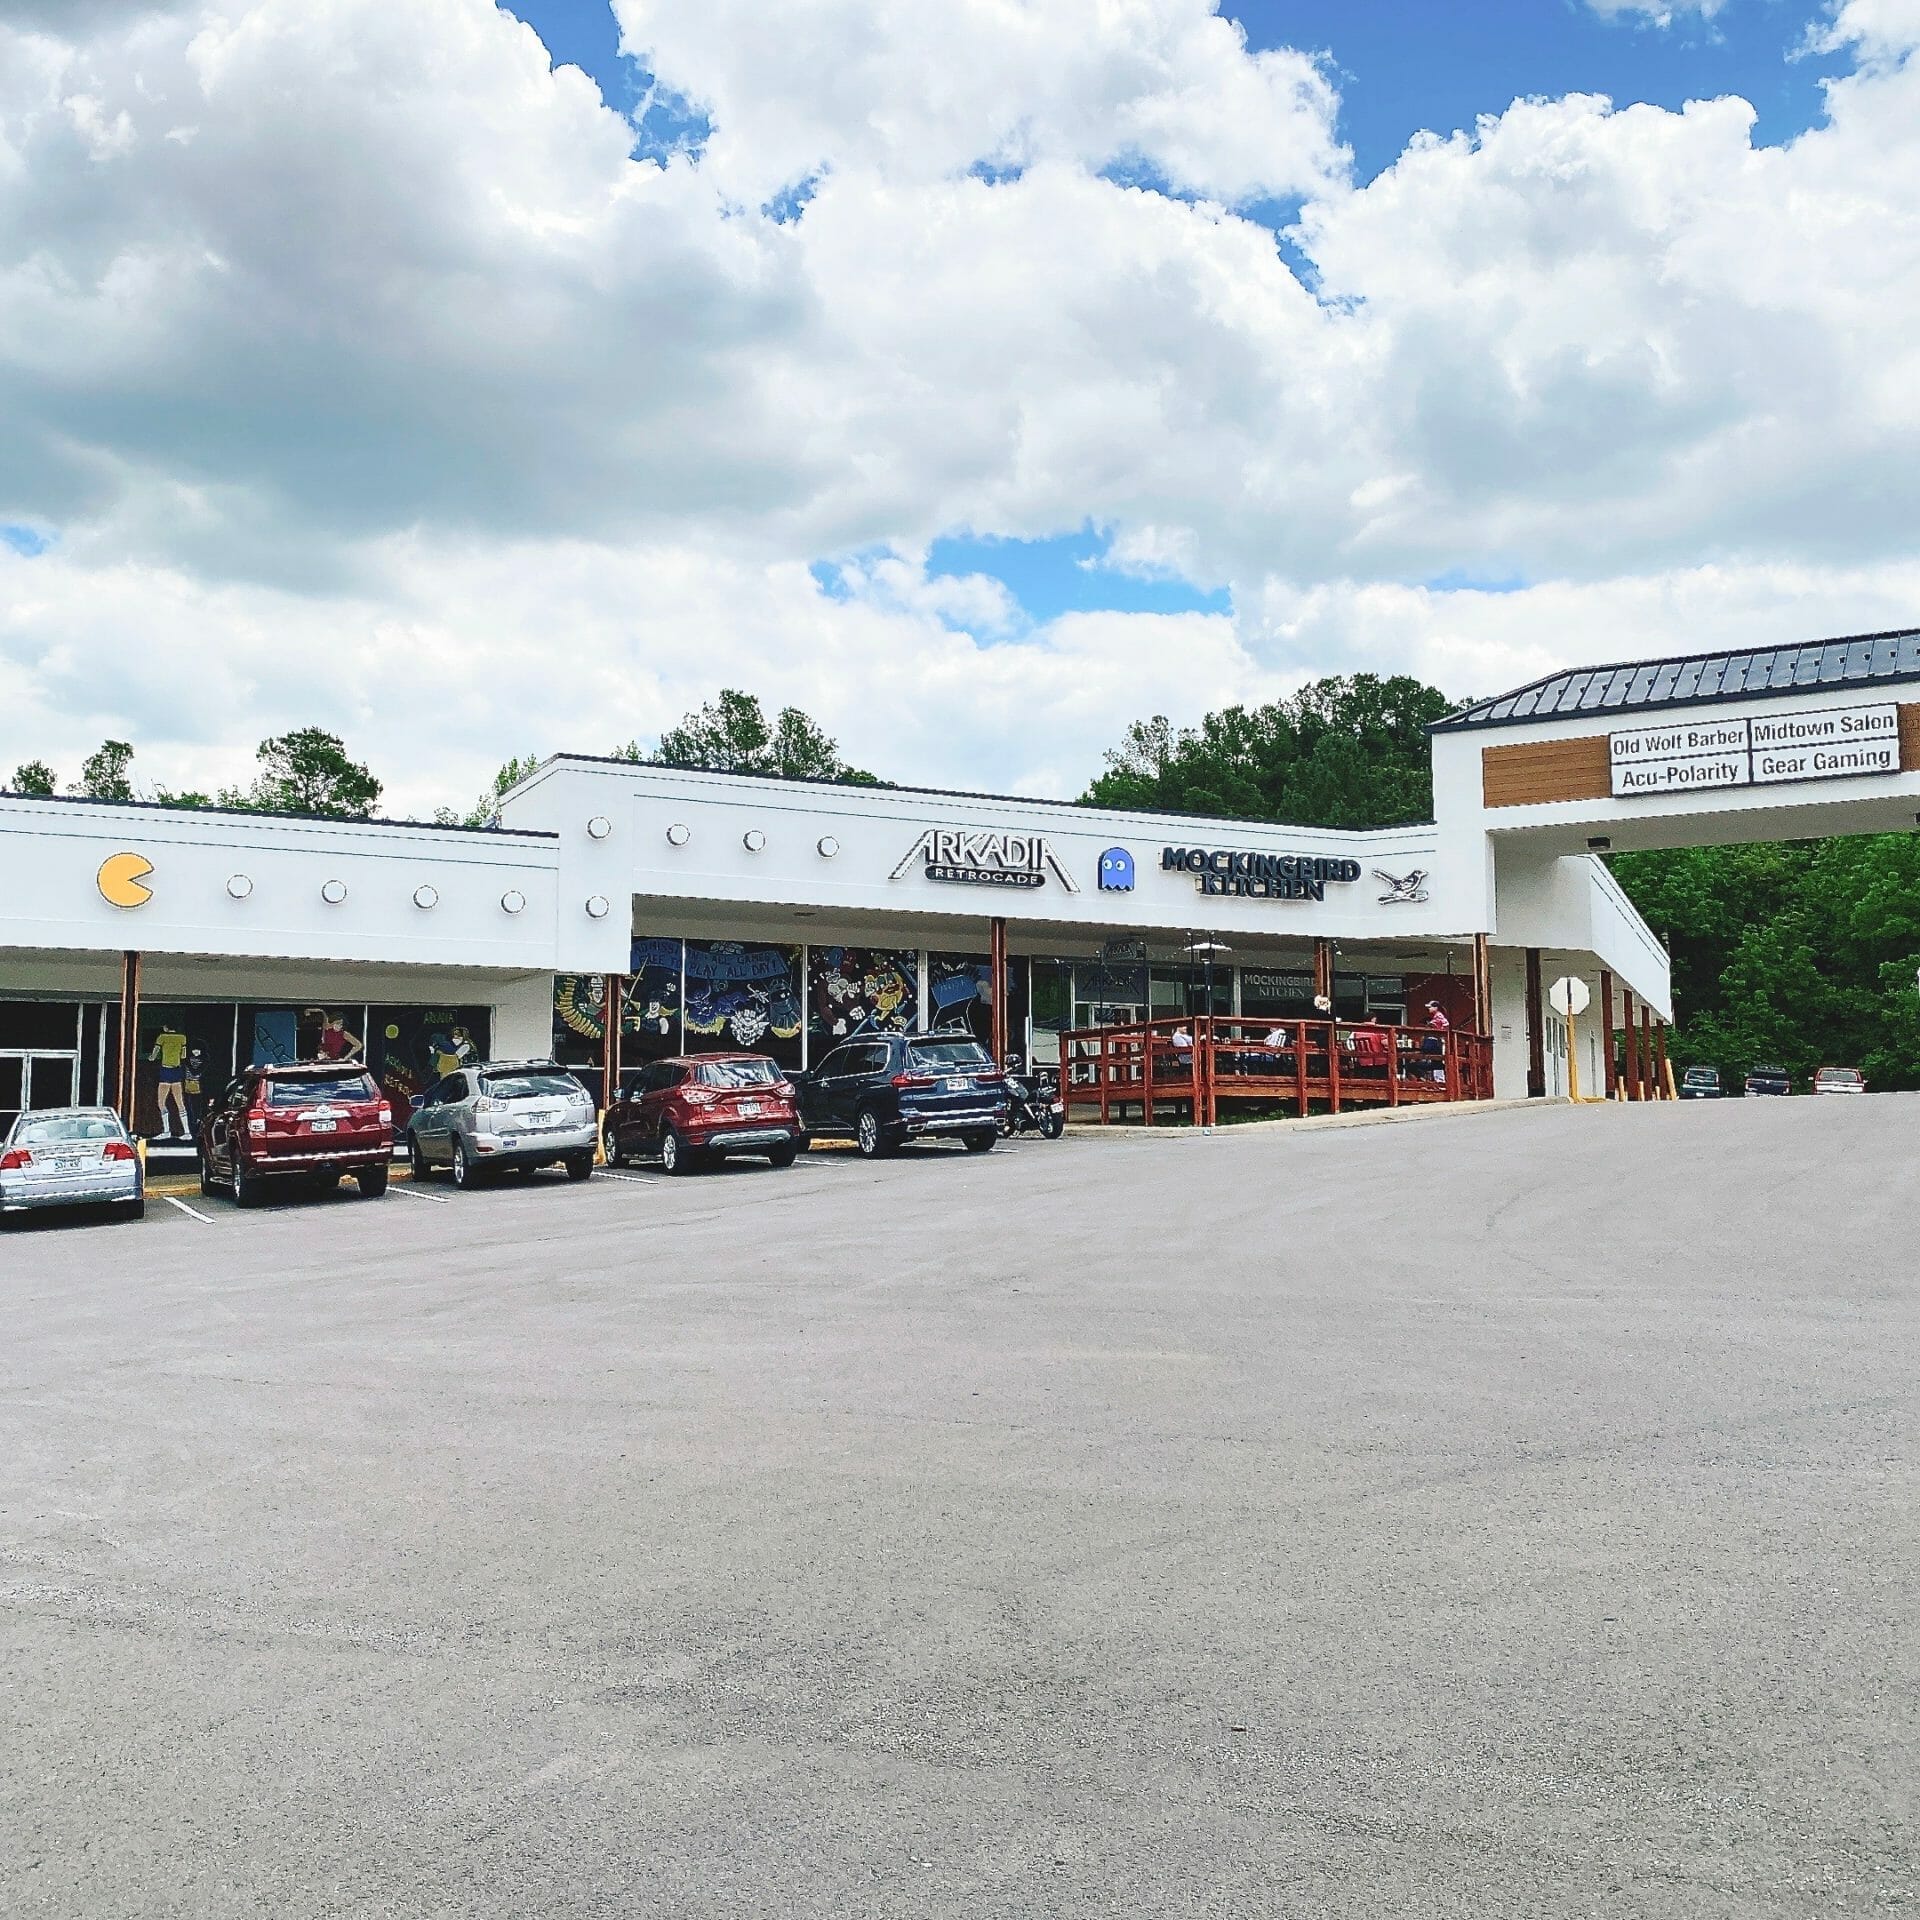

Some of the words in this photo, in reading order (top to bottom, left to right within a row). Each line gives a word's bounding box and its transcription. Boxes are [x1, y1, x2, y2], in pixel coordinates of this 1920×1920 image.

[1754, 721, 1834, 742] Midtown
[1840, 712, 1894, 733] Salon
[1613, 738, 1640, 756] Old
[1645, 734, 1682, 753] Wolf
[1688, 728, 1743, 748] Barber
[1622, 761, 1739, 789] Acu-Polarity
[1762, 755, 1806, 776] Gear
[1814, 749, 1891, 772] Gaming
[888, 828, 1081, 894] ARKADIA
[1161, 846, 1362, 882] MOCKINGBIRD
[935, 866, 1040, 886] RETROCADE
[1199, 873, 1326, 901] KITCHEN
[1259, 986, 1305, 998] KITCHEN
